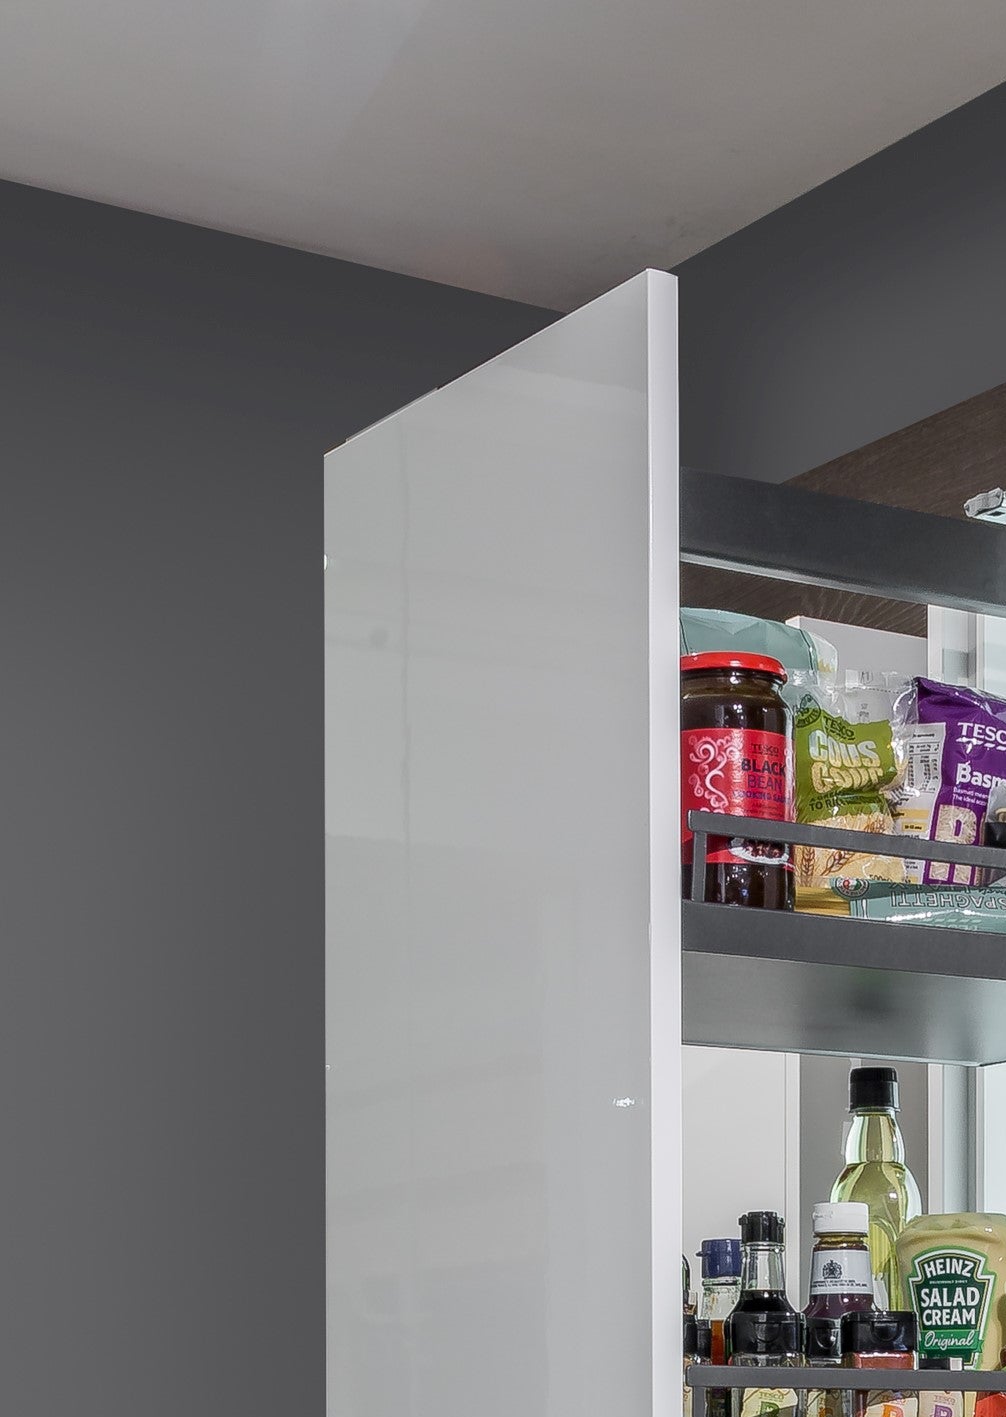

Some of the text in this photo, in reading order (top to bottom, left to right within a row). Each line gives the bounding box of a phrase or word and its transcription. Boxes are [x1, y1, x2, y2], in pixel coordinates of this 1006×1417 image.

[824, 716, 855, 737] TESCO
[751, 744, 779, 753] TESCO
[808, 730, 880, 767] COUS
[741, 758, 786, 776] BLACK
[748, 776, 783, 790] BEAN
[809, 801, 823, 811] TO
[924, 1257, 975, 1278] HEINZ
[921, 1287, 979, 1307] SALAD
[922, 1308, 976, 1326] CREAM
[924, 1330, 975, 1350] Original
